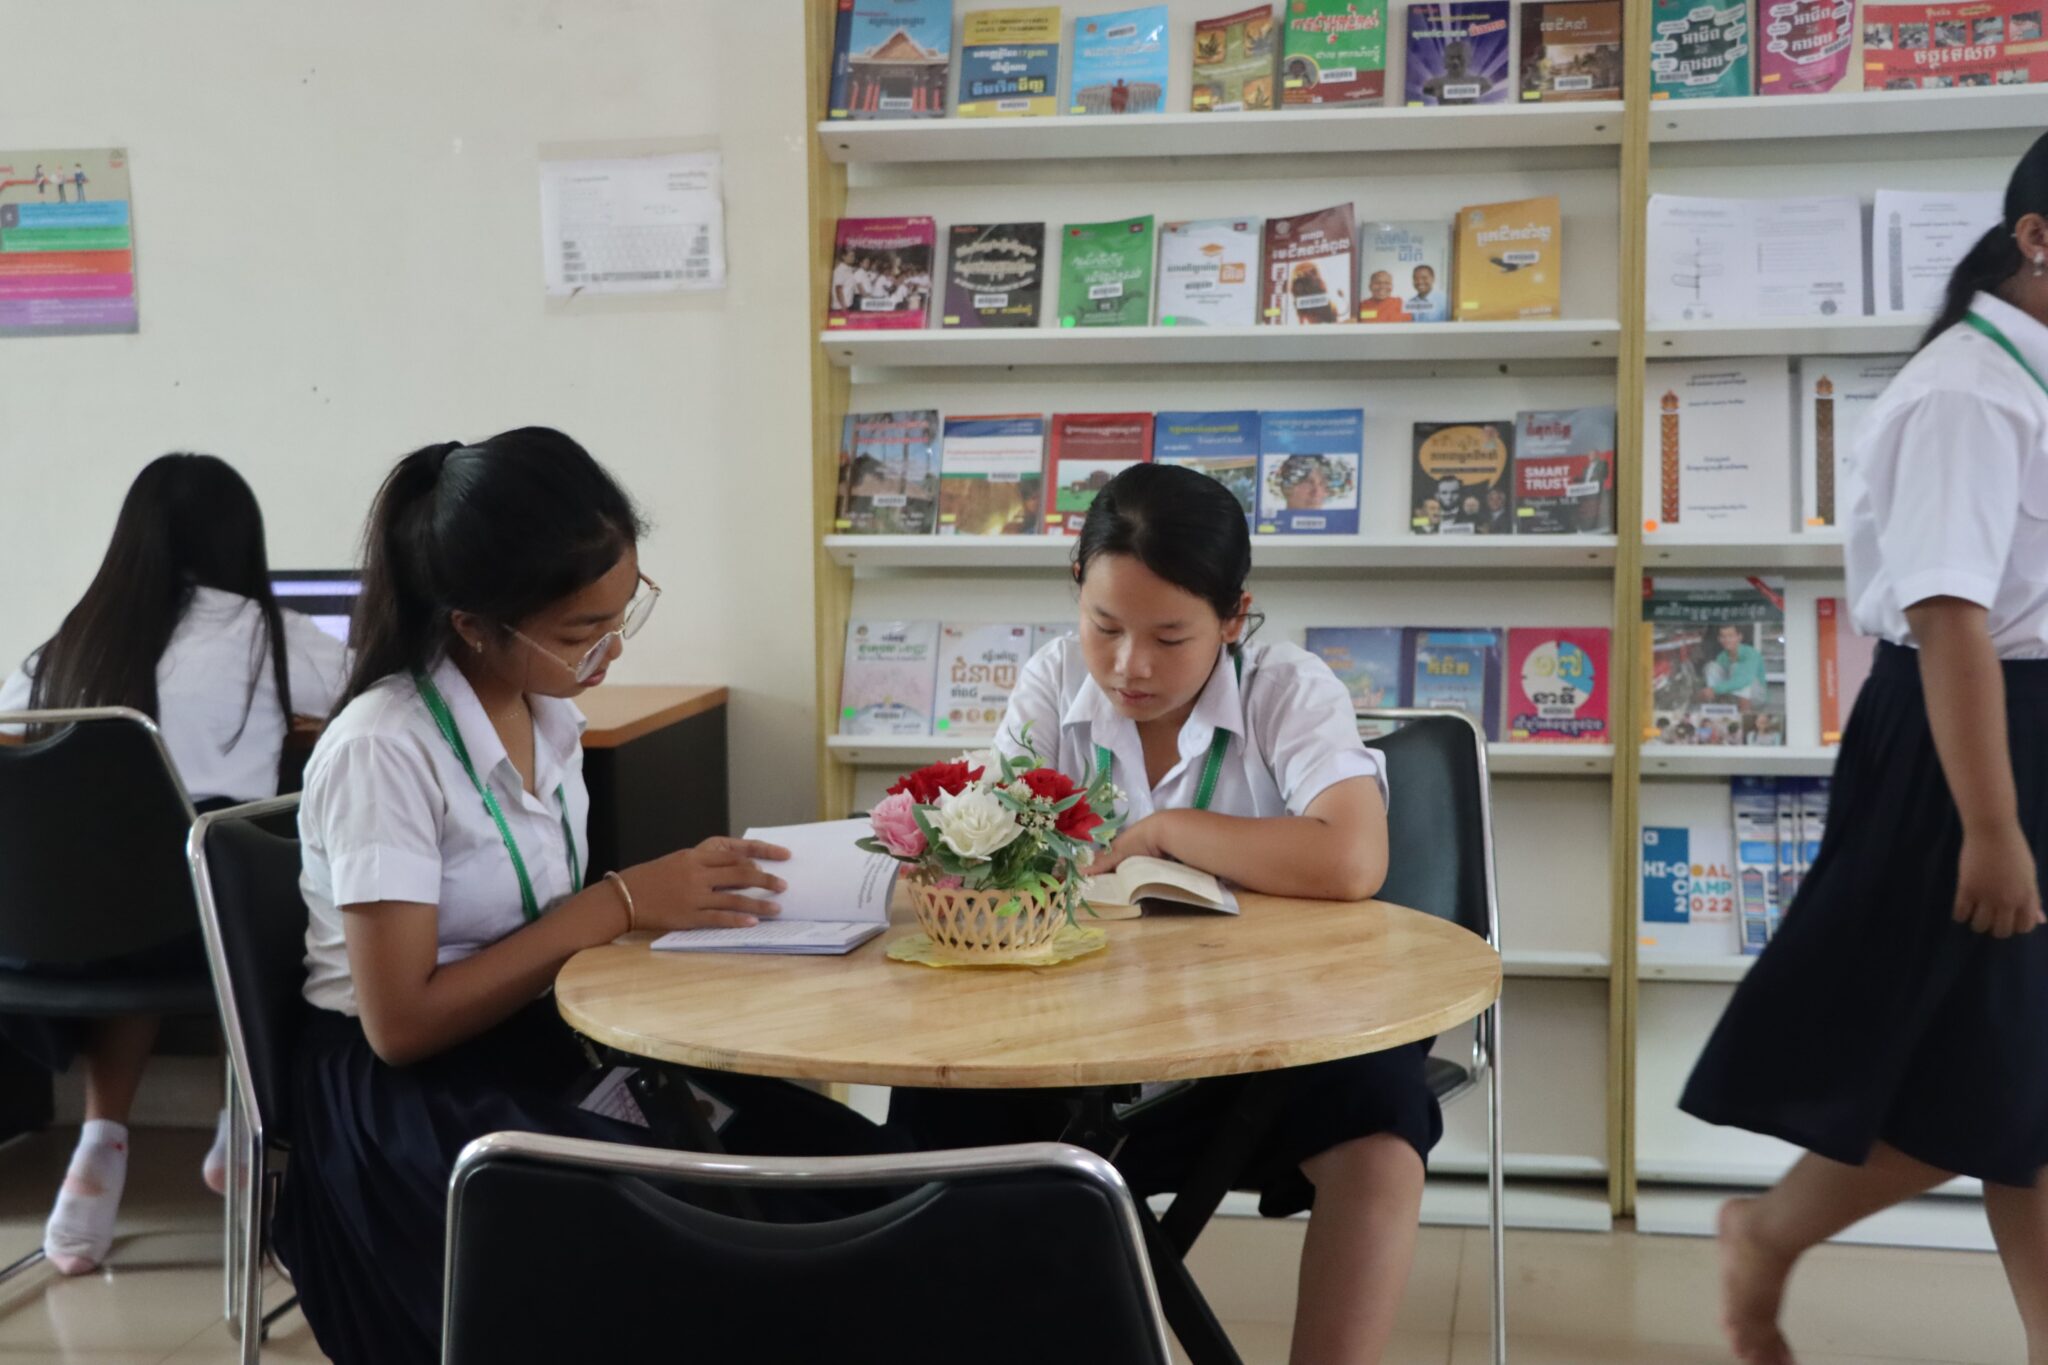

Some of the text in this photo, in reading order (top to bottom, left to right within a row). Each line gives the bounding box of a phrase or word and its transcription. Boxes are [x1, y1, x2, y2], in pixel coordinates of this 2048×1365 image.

[1525, 465, 1569, 478] SMART
[1525, 478, 1569, 490] TRUST
[1644, 861, 1730, 879] HI-GOAL
[1672, 880, 1732, 896] CAMP
[1674, 896, 1733, 913] 2022
